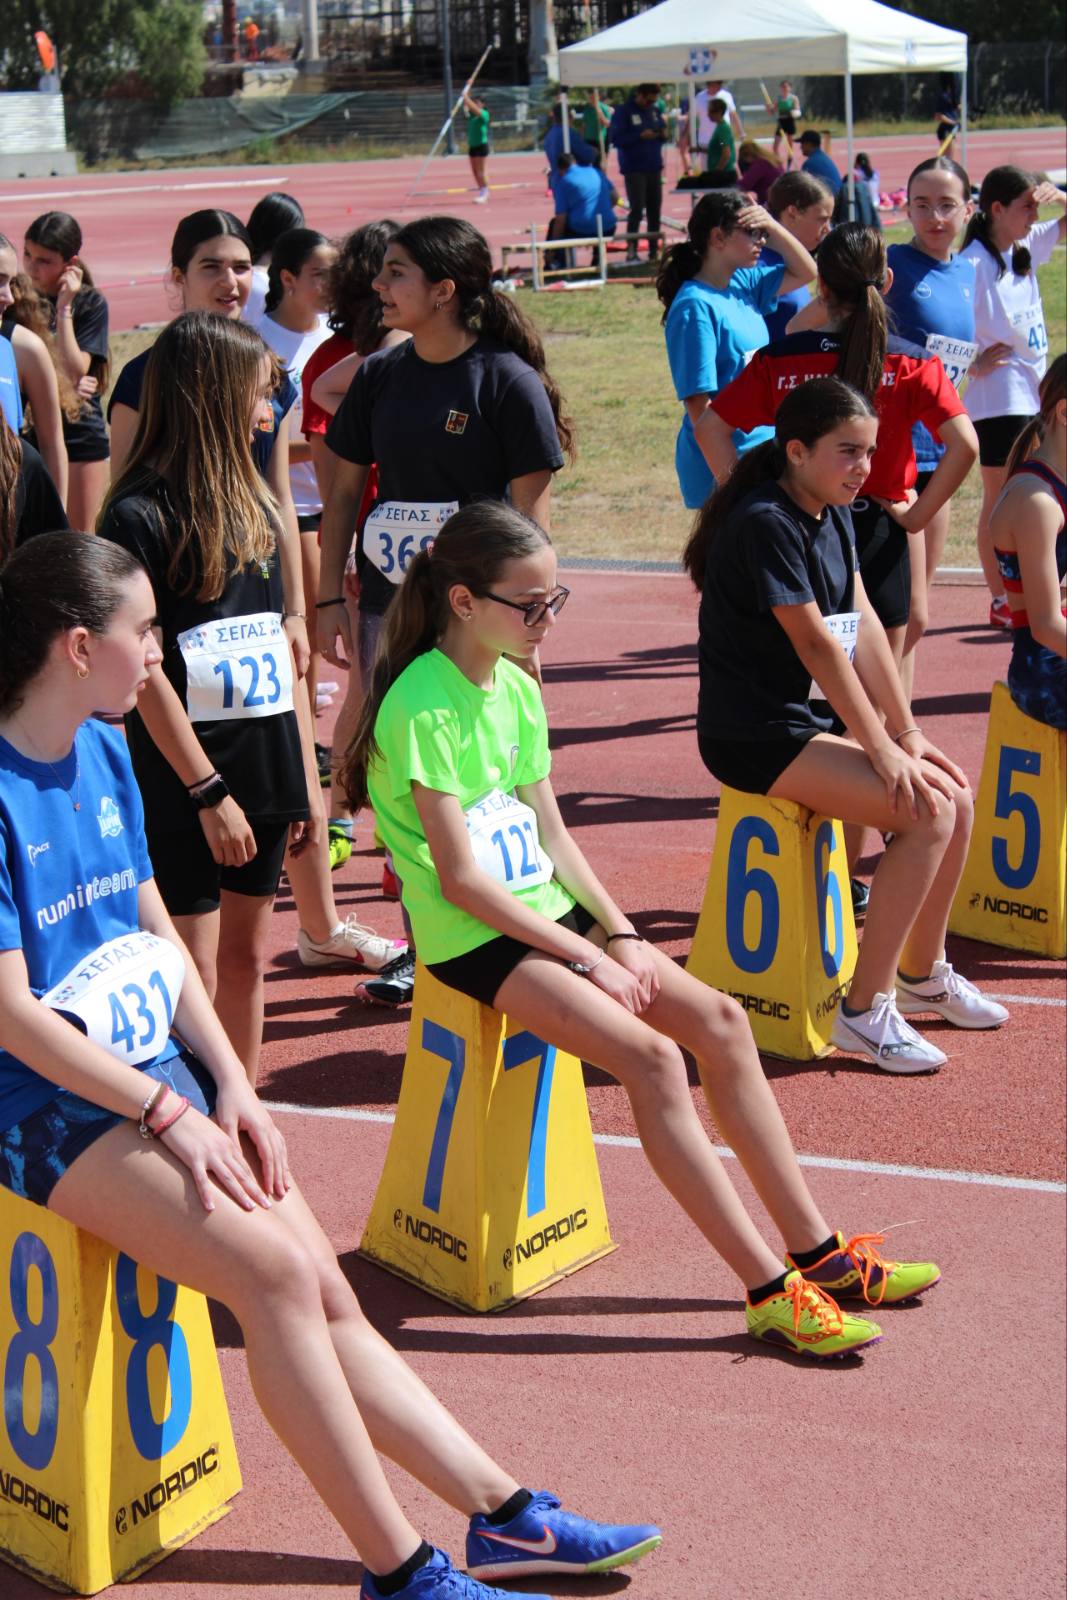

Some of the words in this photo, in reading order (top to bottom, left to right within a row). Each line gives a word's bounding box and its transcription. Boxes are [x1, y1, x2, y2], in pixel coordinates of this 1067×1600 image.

[385, 507, 431, 522] ΣΕΓΑΣ
[215, 621, 267, 643] ΣΕΓΑΣ
[213, 652, 281, 709] 123
[491, 821, 543, 882] 12
[992, 744, 1041, 890] 5
[725, 815, 780, 974] 6
[815, 820, 843, 979] 6
[983, 896, 1048, 925] NORDIC
[76, 942, 141, 981] ΣΕΓΑΣ
[107, 969, 173, 1054] 431
[717, 988, 790, 1021] ORDIC
[421, 1017, 467, 1214] 7
[502, 1030, 558, 1218] 7
[405, 1215, 468, 1263] NORDIC
[515, 1208, 588, 1264] NORDIC
[4, 1231, 60, 1471] 8
[115, 1250, 192, 1461] 8
[131, 1447, 218, 1526] NORDIC
